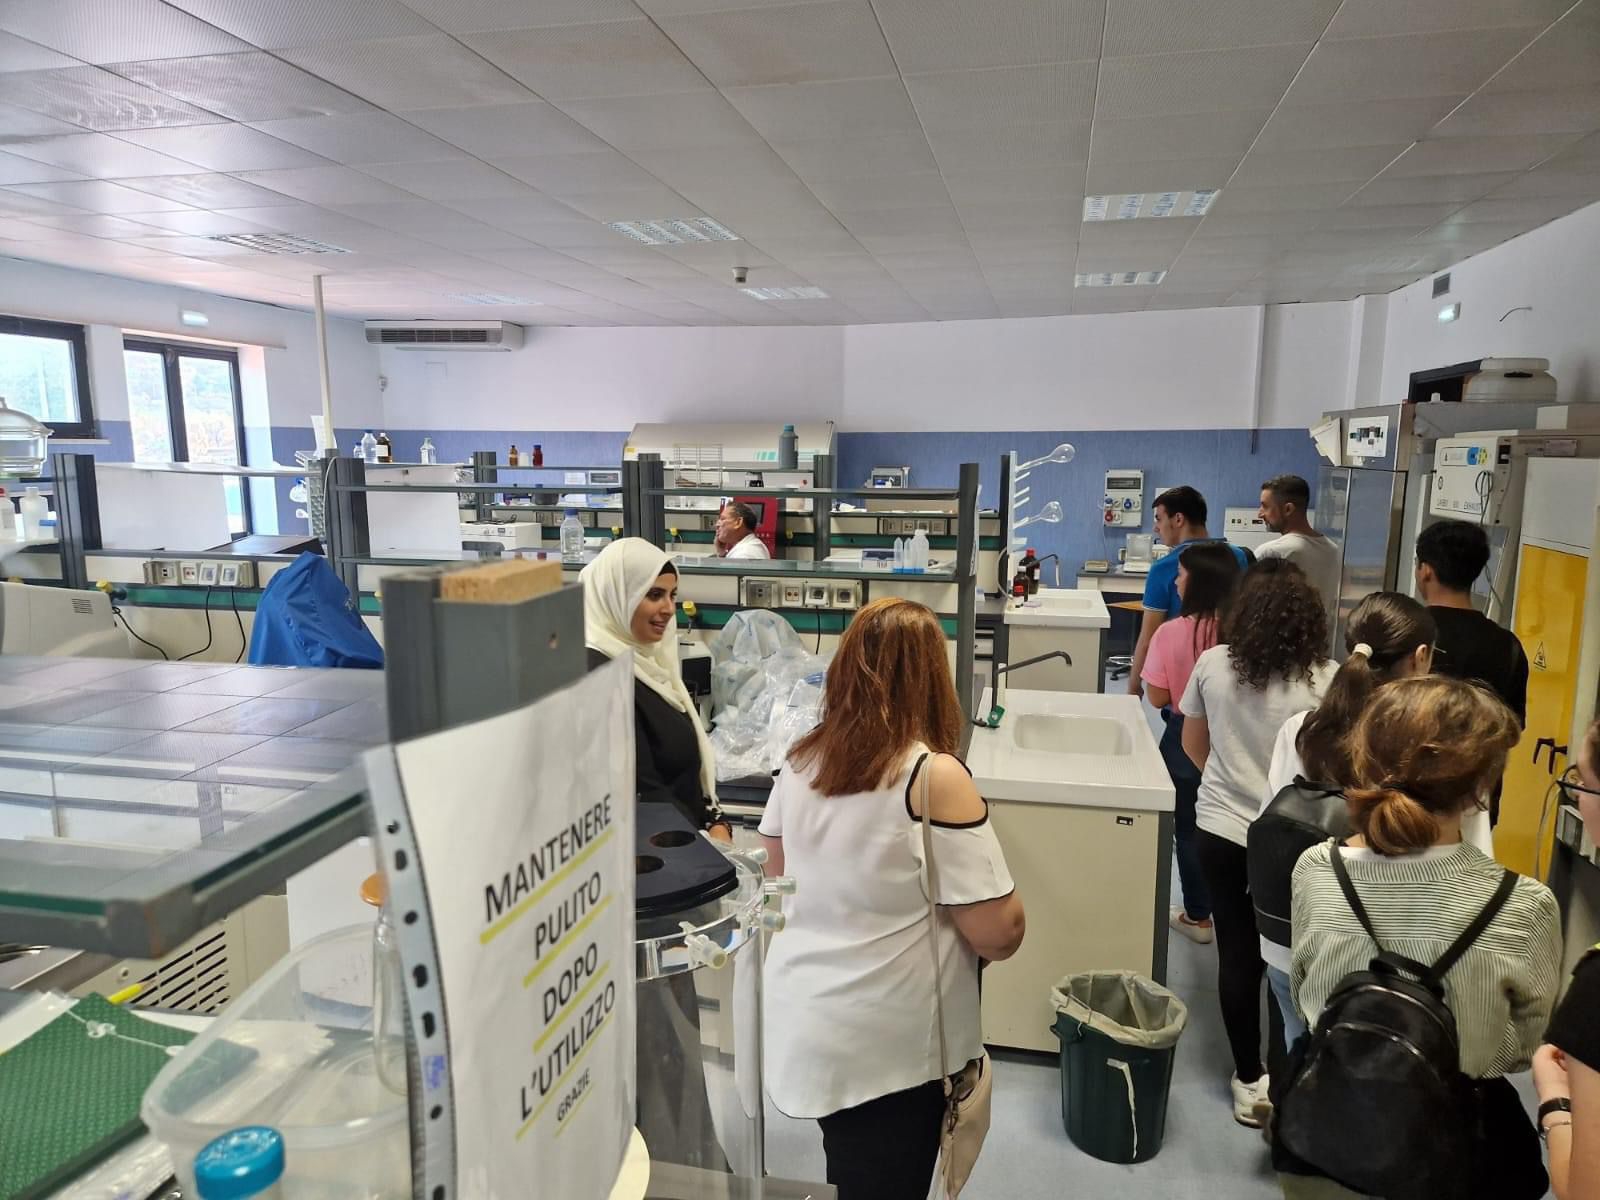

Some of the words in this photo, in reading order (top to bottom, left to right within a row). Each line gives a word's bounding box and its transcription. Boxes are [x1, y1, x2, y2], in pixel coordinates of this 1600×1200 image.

[485, 793, 612, 923] MANTENERE
[535, 872, 601, 961] PULITO
[543, 942, 598, 1026] DOPO
[521, 980, 616, 1122] L'UTILIZZO
[557, 1066, 591, 1123] GRAZIE
